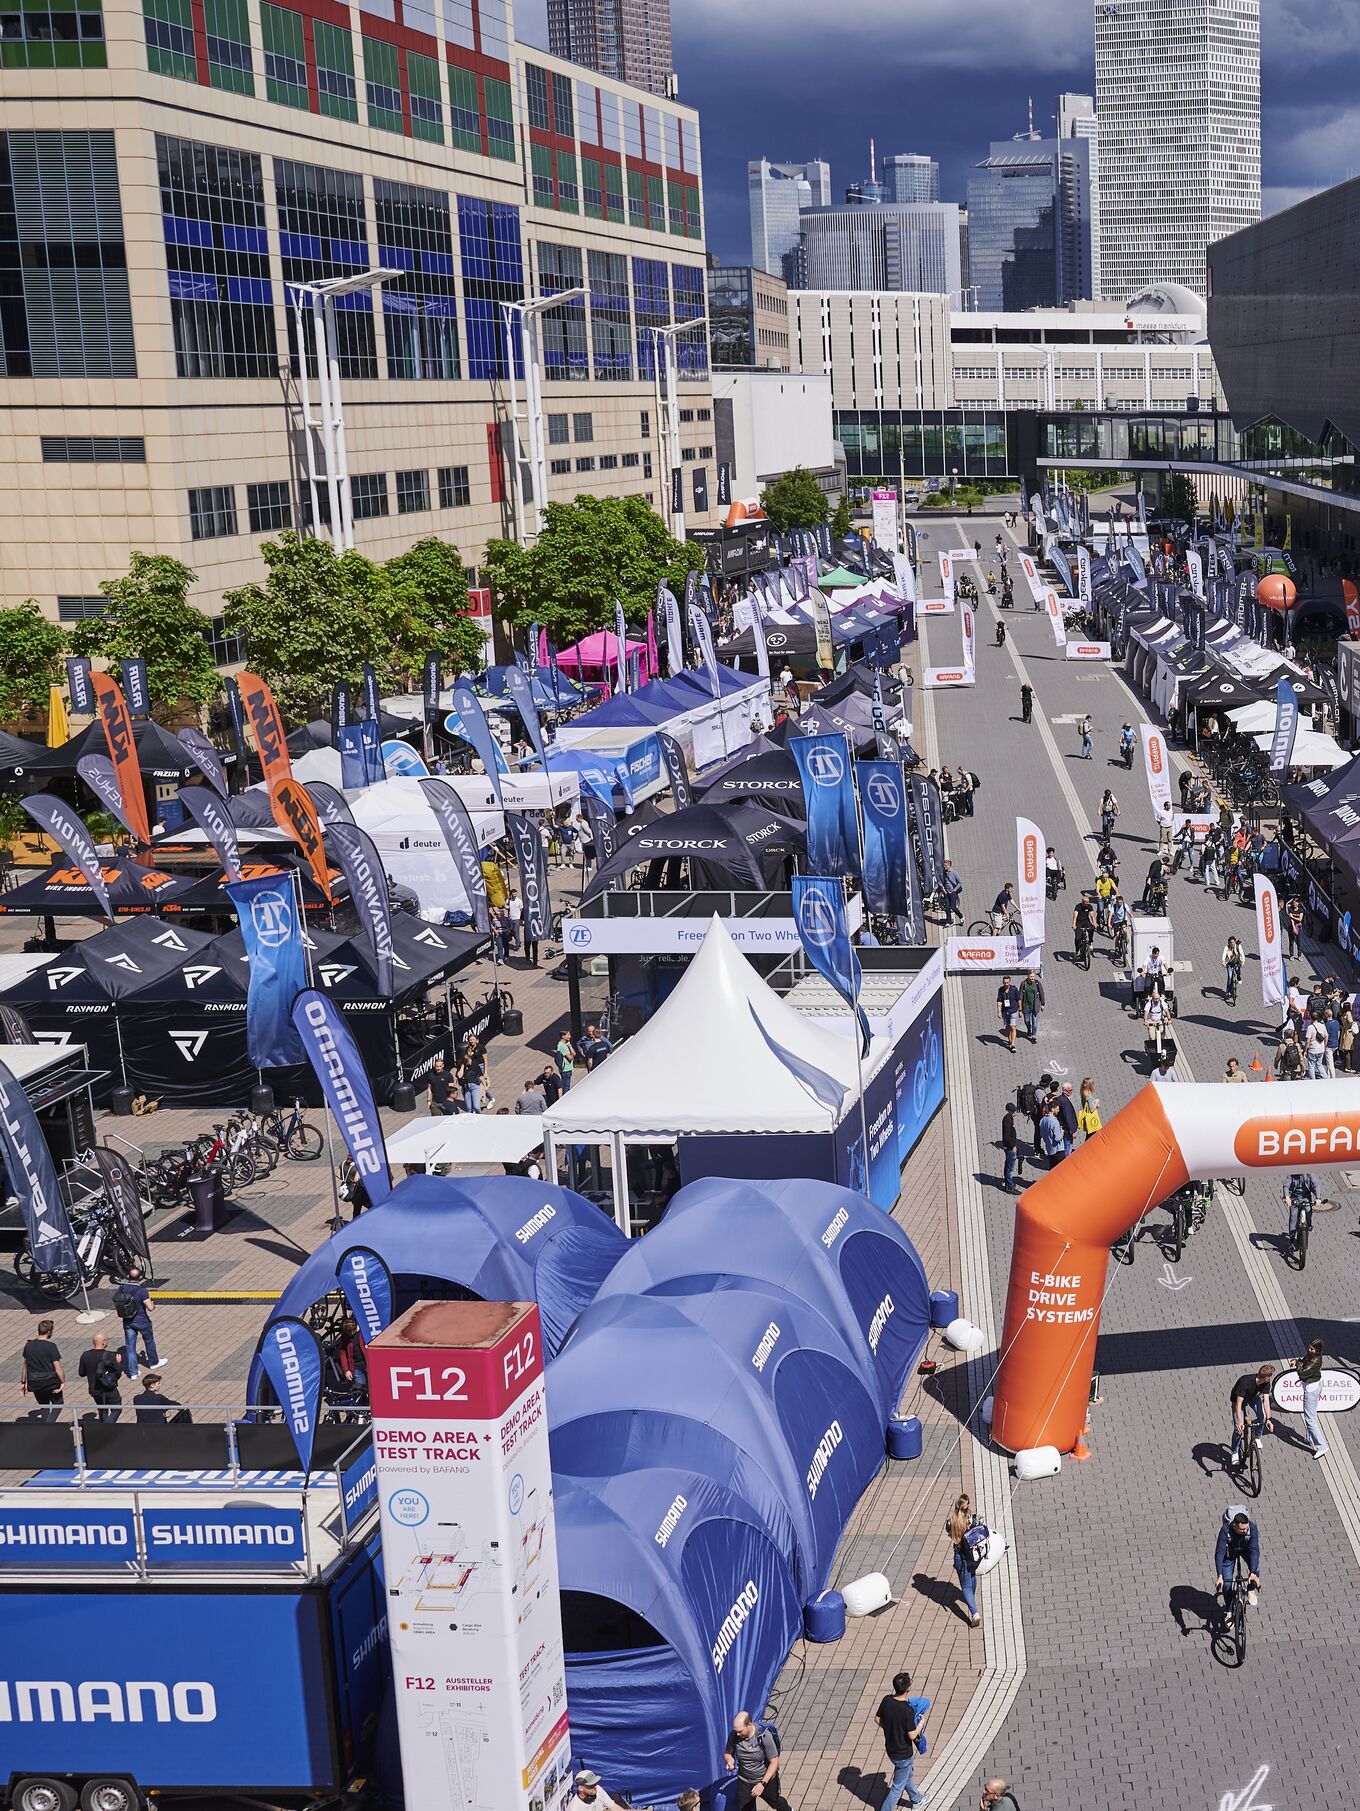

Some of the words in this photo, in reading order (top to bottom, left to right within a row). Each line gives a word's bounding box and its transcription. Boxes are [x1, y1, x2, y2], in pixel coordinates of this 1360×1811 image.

[1135, 322, 1158, 331] messe
[1160, 320, 1188, 331] frankfurt
[719, 465, 728, 499] AMFLOW
[429, 661, 437, 705] Panasonic
[1329, 678, 1340, 724] SIMPLON
[1151, 740, 1160, 771] BAFANG
[723, 780, 800, 789] STORCK
[1328, 804, 1360, 828] pinion
[413, 840, 441, 848] deuter
[639, 839, 727, 849] STORCK
[746, 821, 781, 845] STORCK
[1026, 839, 1034, 879] BAFANG
[1263, 895, 1274, 938] BAFANG
[572, 927, 589, 944] ZF
[731, 932, 746, 941] on
[748, 930, 772, 941] Two
[961, 951, 991, 959] BAFANG
[66, 1005, 109, 1013] RAYMON
[204, 1003, 247, 1012] RAYMON
[343, 1002, 386, 1010] RAYMON
[869, 1103, 887, 1141] Freedom
[887, 1100, 893, 1114] on
[870, 1140, 879, 1161] Two
[878, 1119, 894, 1152] Wheels
[515, 1204, 557, 1244] SHIMANO
[821, 1206, 850, 1249] SHIMANO
[1030, 1272, 1081, 1289] E-BIKE
[1029, 1290, 1076, 1306] DRIVE
[868, 1294, 895, 1356] SHIMANO
[1027, 1307, 1093, 1323] SYSTEMS
[751, 1321, 781, 1373] SHIMANO
[503, 1331, 536, 1390] F12
[389, 1366, 468, 1401] F12
[1320, 1379, 1353, 1389] LEASE
[1330, 1394, 1354, 1402] BITTE
[500, 1413, 520, 1440] DEMO
[522, 1393, 541, 1421] AREA
[376, 1431, 426, 1443] DEMO
[432, 1431, 478, 1444] AREA
[502, 1430, 517, 1456] TEST
[519, 1405, 542, 1434] TRACK
[379, 1448, 421, 1460] TEST
[423, 1448, 481, 1461] TRACK
[806, 1419, 844, 1500] SHIMANO
[379, 1466, 418, 1474] powered
[420, 1465, 430, 1475] by
[433, 1466, 470, 1474] BAFANG
[397, 1497, 419, 1506] YOU
[655, 1494, 688, 1548] SHIMANO
[151, 1525, 295, 1545] SHIMANO
[711, 1579, 759, 1675] SHIMANO
[530, 1642, 546, 1667] TRACK
[405, 1677, 435, 1690] F12
[445, 1677, 493, 1685] AUSSTELLER
